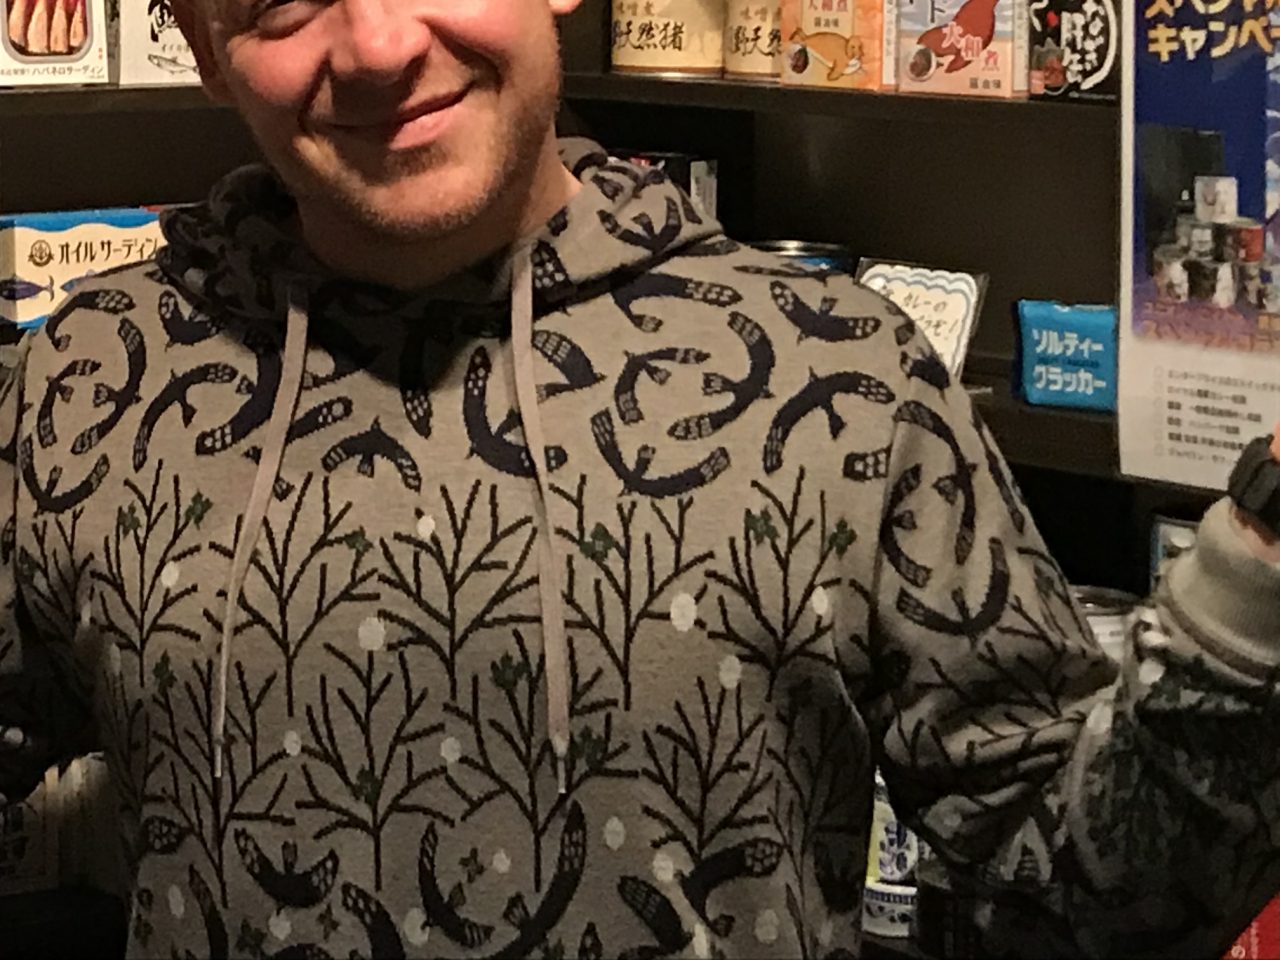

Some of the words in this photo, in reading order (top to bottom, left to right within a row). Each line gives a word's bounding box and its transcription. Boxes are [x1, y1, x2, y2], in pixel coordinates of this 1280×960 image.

[58, 237, 158, 266] オイルサーディン
[1032, 328, 1105, 357] ソルティー
[1032, 365, 1107, 395] クラッカー
